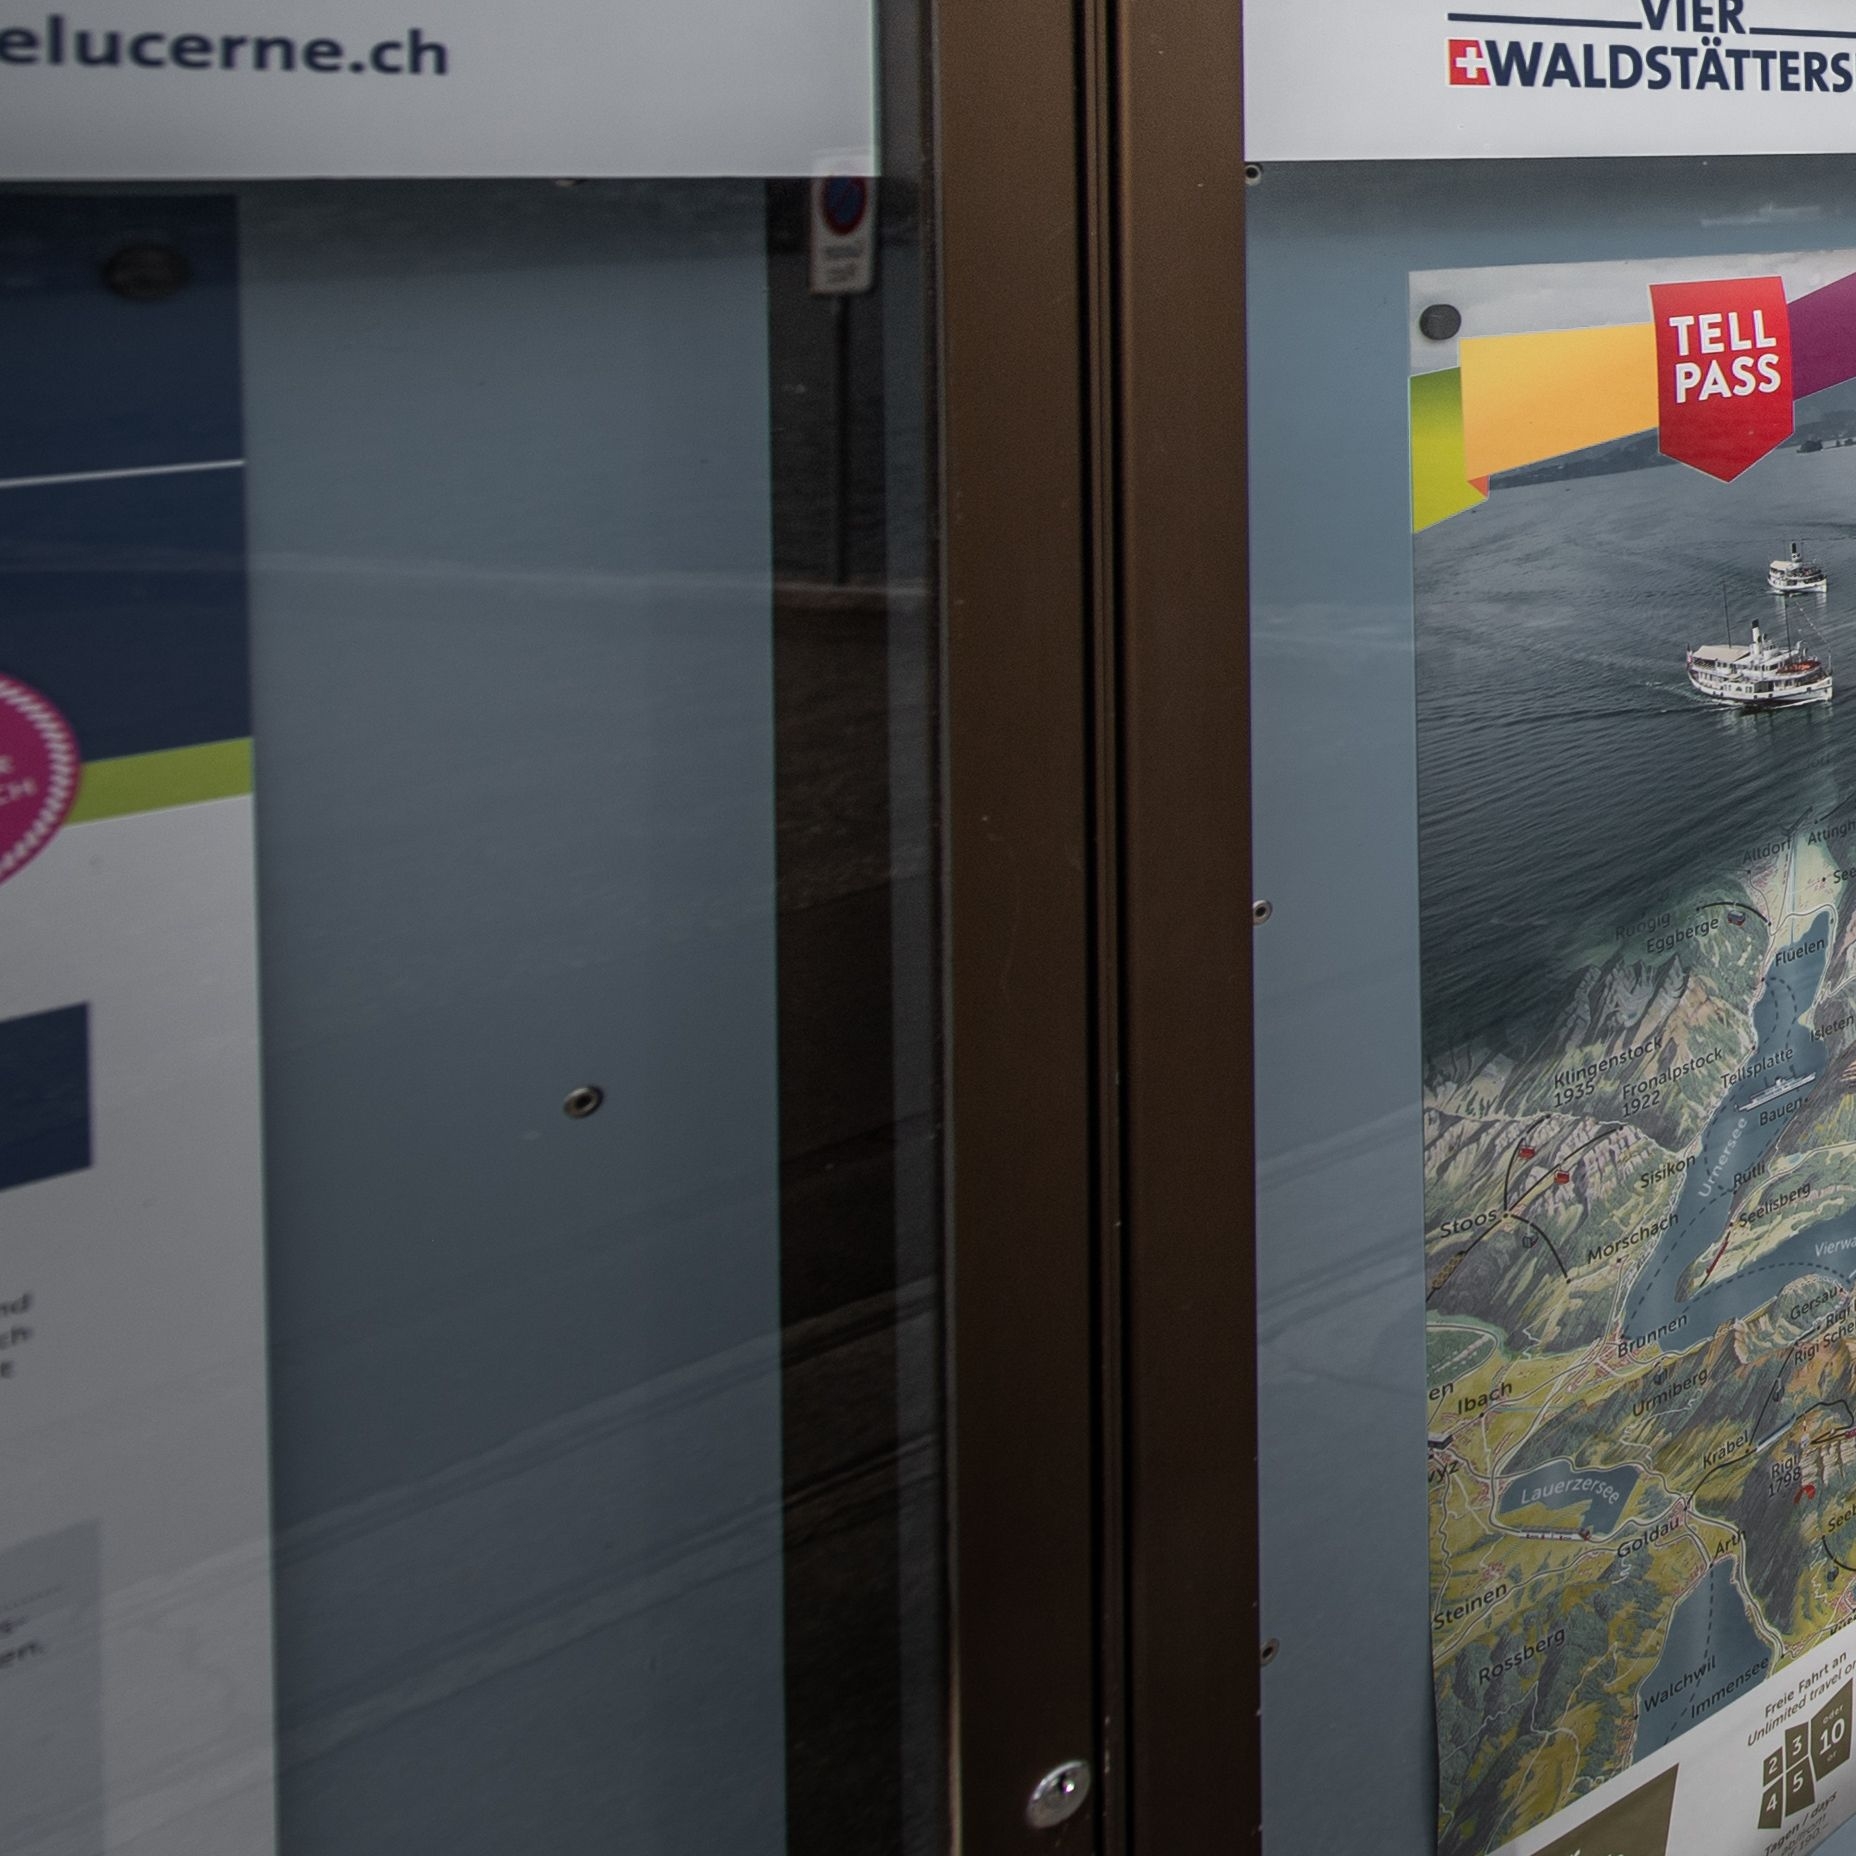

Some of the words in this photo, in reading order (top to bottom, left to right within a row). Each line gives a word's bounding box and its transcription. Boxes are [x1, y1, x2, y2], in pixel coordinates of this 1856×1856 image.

[0, 13, 448, 75] elucerne.ch
[1669, 308, 1777, 356] TELL
[1675, 352, 1782, 404] PASS
[1742, 837, 1792, 864] Altdorf
[1646, 916, 1720, 954] Eggberge
[1775, 937, 1826, 968] Flüelen
[1810, 1014, 1855, 1043] Isleten
[1553, 1035, 1663, 1090] Klingenstock
[1622, 1047, 1724, 1101] Fronalpstock
[1720, 1047, 1794, 1089] Tellsplatte
[1553, 1079, 1596, 1109] 1935
[1622, 1090, 1661, 1119] 1922
[1760, 1096, 1801, 1127] Bauen
[1639, 1154, 1696, 1190] Sisikon
[1698, 1117, 1748, 1198] Urnersee
[1733, 1159, 1766, 1189] Rütli
[1739, 1181, 1811, 1229] Seelisberg
[1439, 1208, 1498, 1240] Stoos
[1587, 1212, 1680, 1265] Morschach
[1790, 1287, 1838, 1321] Gersau
[1825, 1305, 1851, 1330] Rigi
[1617, 1314, 1689, 1359] Brunnen
[1794, 1342, 1820, 1366] Rigi
[1457, 1380, 1513, 1416] Ibach
[1632, 1367, 1709, 1418] Urmiberg
[1702, 1429, 1750, 1470] Krabel
[1771, 1454, 1800, 1480] Rigi
[1520, 1476, 1620, 1506] Lauerzersee
[1768, 1469, 1801, 1498] 1798
[1616, 1515, 1681, 1559] Goldau
[1714, 1528, 1747, 1557] Arth
[1432, 1582, 1508, 1632] Steinen
[1478, 1627, 1566, 1687] Rossberg
[1643, 1654, 1717, 1714] Walchwil
[1690, 1655, 1770, 1720] Immensee
[1764, 1688, 1795, 1719] Freie
[1798, 1664, 1830, 1694] Fahrt
[1832, 1651, 1847, 1668] an
[1747, 1695, 1807, 1747] Unlimited
[1810, 1669, 1842, 1702] travel
[1822, 1704, 1844, 1725] oder
[1791, 1735, 1802, 1757] 3
[1818, 1717, 1845, 1755] 10
[1768, 1757, 1778, 1775] 2
[1792, 1769, 1804, 1793] 5
[1765, 1793, 1778, 1812] 4
